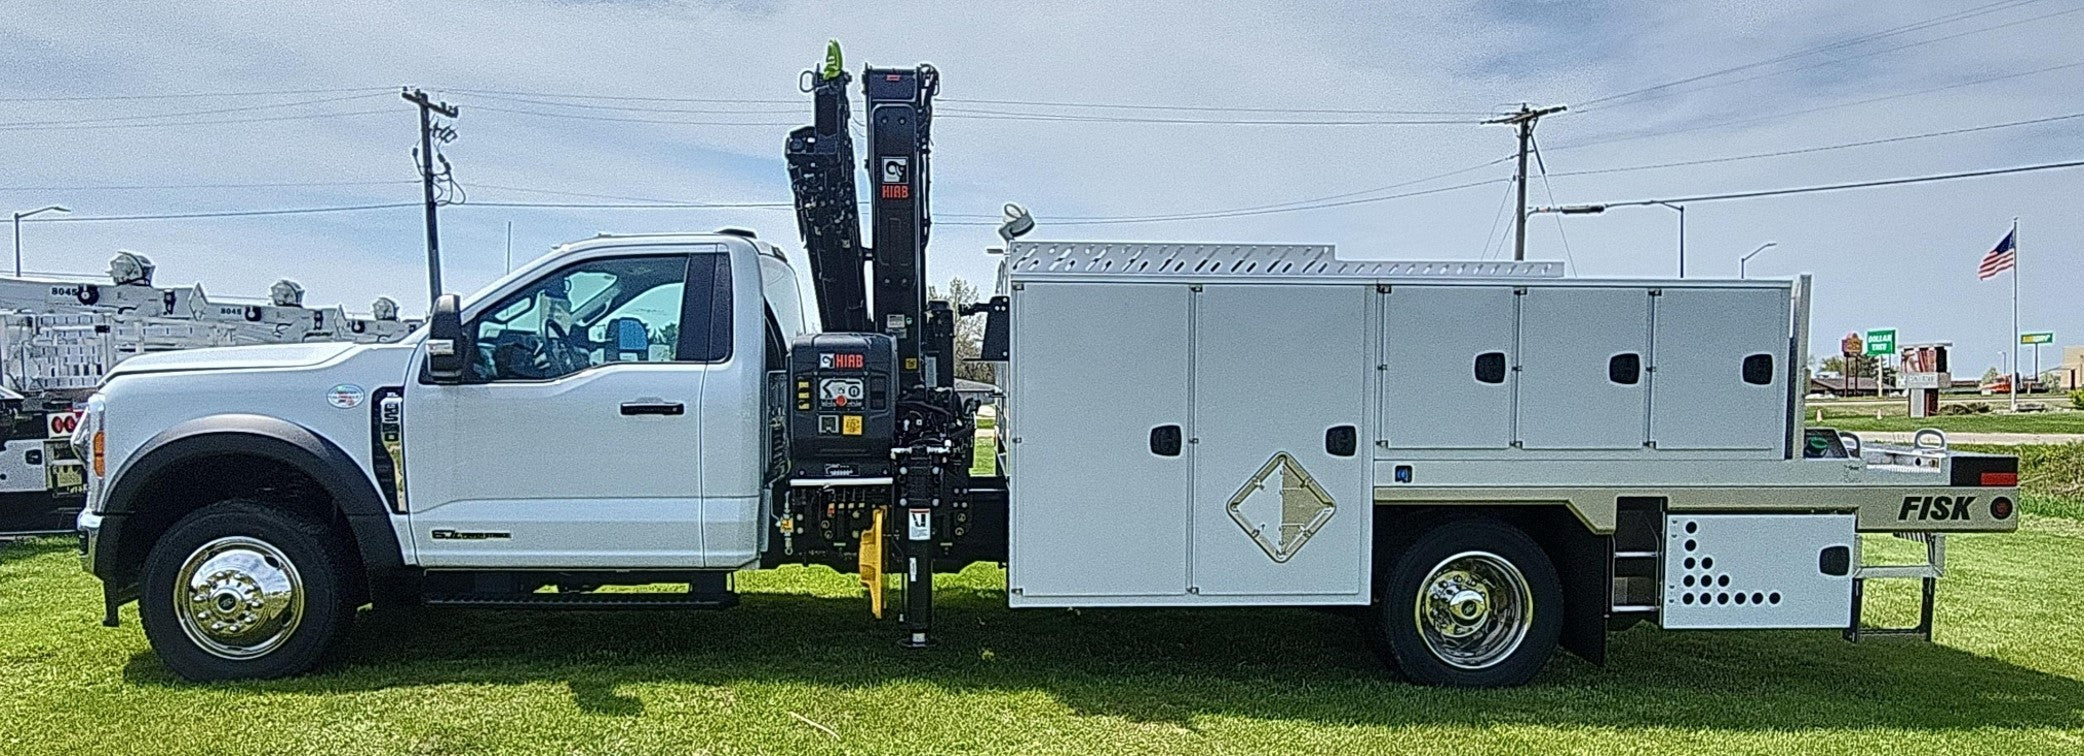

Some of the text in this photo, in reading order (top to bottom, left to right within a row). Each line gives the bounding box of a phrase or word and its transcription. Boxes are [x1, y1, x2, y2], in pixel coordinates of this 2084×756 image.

[882, 185, 909, 198] HIAB
[51, 287, 78, 296] 8045
[836, 354, 864, 368] HIAB
[1898, 496, 1977, 521] FISK
